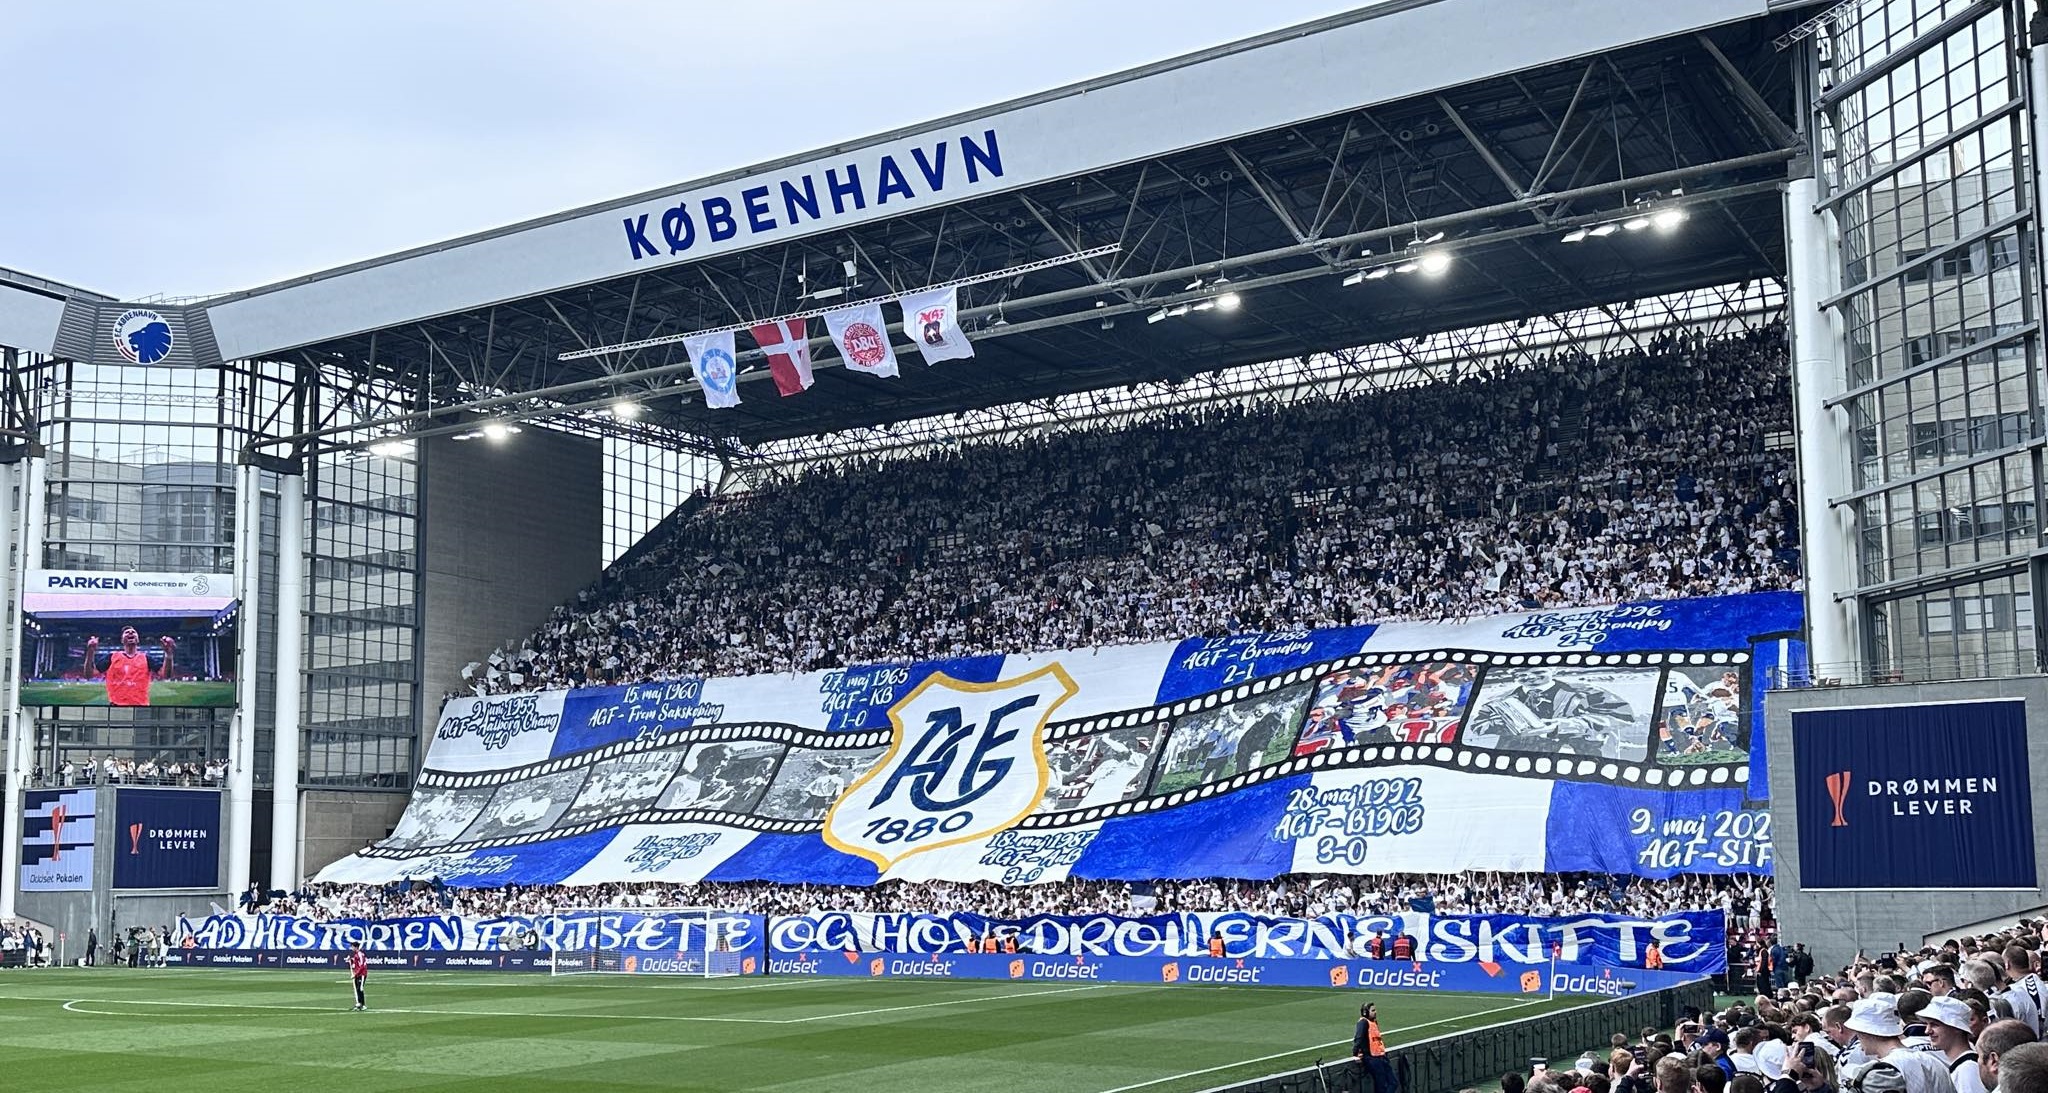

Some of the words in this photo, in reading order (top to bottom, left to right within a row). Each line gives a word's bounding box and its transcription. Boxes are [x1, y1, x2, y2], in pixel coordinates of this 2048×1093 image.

[622, 129, 1004, 261] KØBENHAVN
[48, 576, 128, 589] PARKEN
[1202, 637, 1225, 649] 12.
[1230, 635, 1261, 646] maj
[1502, 624, 1558, 639] AGF
[1557, 632, 1607, 647] 2-0
[1182, 648, 1228, 669] AGF
[820, 672, 843, 693] 27.
[847, 673, 870, 691] maj
[871, 668, 910, 686] 1965
[1223, 662, 1255, 684] 2-1
[623, 687, 640, 703] 15.
[642, 688, 663, 705] maj
[664, 682, 698, 701] 1960
[823, 690, 860, 713] AGF
[869, 687, 893, 706] KB
[472, 701, 483, 719] 9.
[505, 696, 538, 718] 1955
[588, 706, 619, 727] AGF
[439, 717, 469, 739] AGF
[520, 712, 559, 732] Chang
[840, 710, 867, 728] 1-0
[483, 731, 510, 750] 4-0
[635, 725, 663, 741] 2-0
[868, 694, 1040, 812] AGF
[1285, 785, 1316, 813] 28.
[1321, 785, 1359, 812] maj
[1361, 777, 1423, 807] 1992
[1868, 777, 1997, 796] DRØMMEN
[1894, 799, 1973, 816] LEVER
[150, 829, 207, 838] DRØMMEN
[862, 811, 973, 844] 1880
[1273, 809, 1330, 841] AGF
[1345, 805, 1424, 836] B1903
[1631, 808, 1655, 834] 9.
[1663, 815, 1707, 843] maj
[1714, 811, 1772, 840] 202
[160, 841, 196, 850] LEVER
[985, 830, 1018, 848] 18.
[1018, 835, 1049, 852] maj
[1048, 829, 1100, 849] 1987
[1317, 836, 1367, 866] 3-0
[979, 848, 1030, 866] AGF
[56, 873, 83, 883] Pokalen
[1002, 867, 1044, 884] 3-0
[253, 918, 460, 950] HISTORIEN
[771, 915, 857, 952] OG
[1431, 919, 1711, 964] SKIFTE
[642, 958, 693, 972] Oddset
[892, 960, 951, 976] Oddset
[1032, 960, 1098, 979] Oddset
[1188, 965, 1260, 983] Oddset
[1358, 967, 1441, 988] Oddset
[1553, 973, 1622, 995] Oddset
